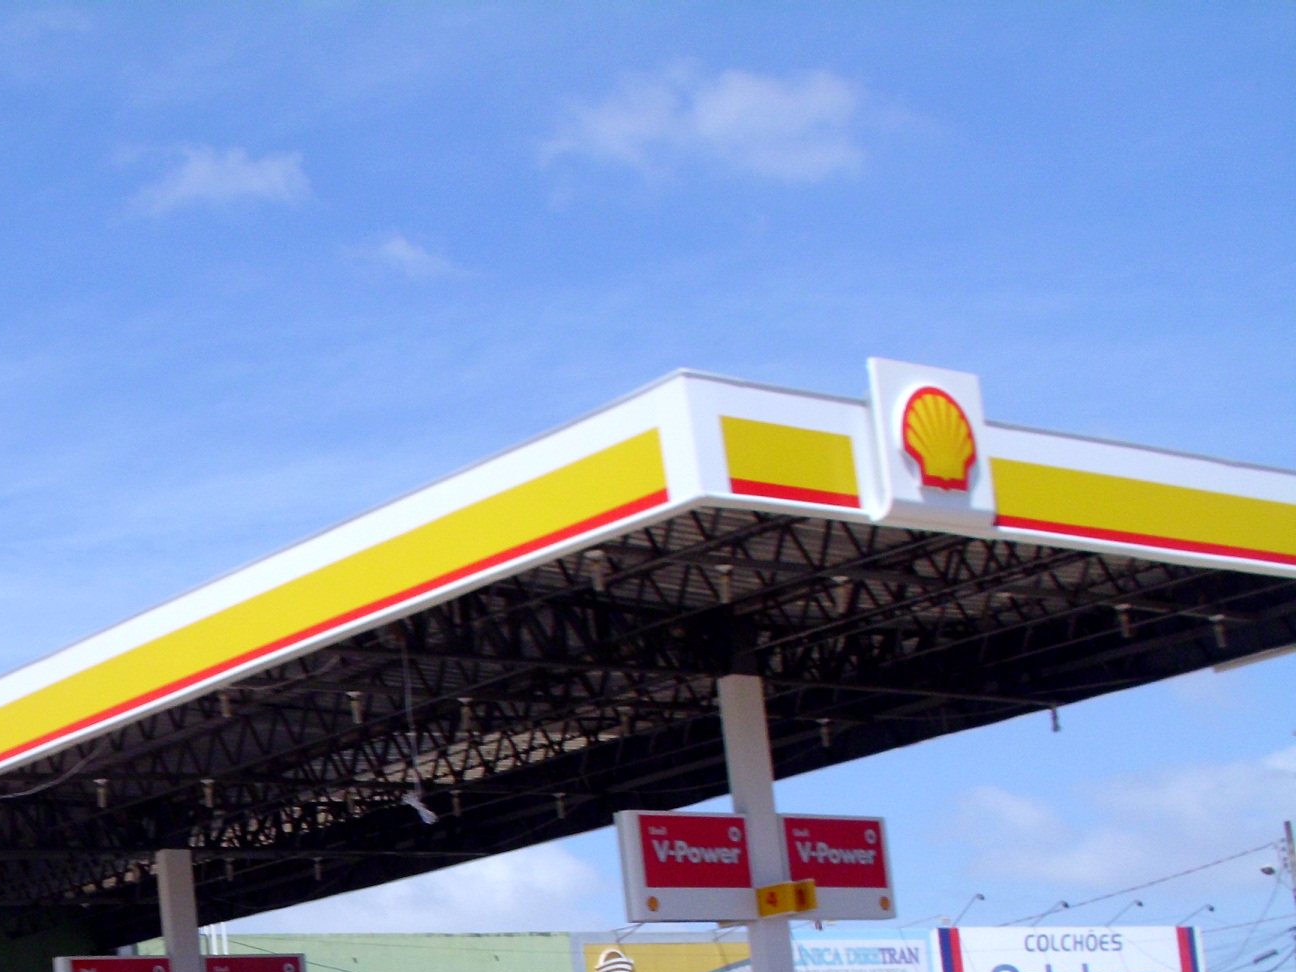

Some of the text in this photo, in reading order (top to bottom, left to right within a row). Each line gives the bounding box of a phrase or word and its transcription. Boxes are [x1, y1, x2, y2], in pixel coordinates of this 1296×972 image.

[652, 840, 742, 864] V-Power
[795, 841, 877, 865] V-Power
[1024, 930, 1123, 952] COLCHÕES
